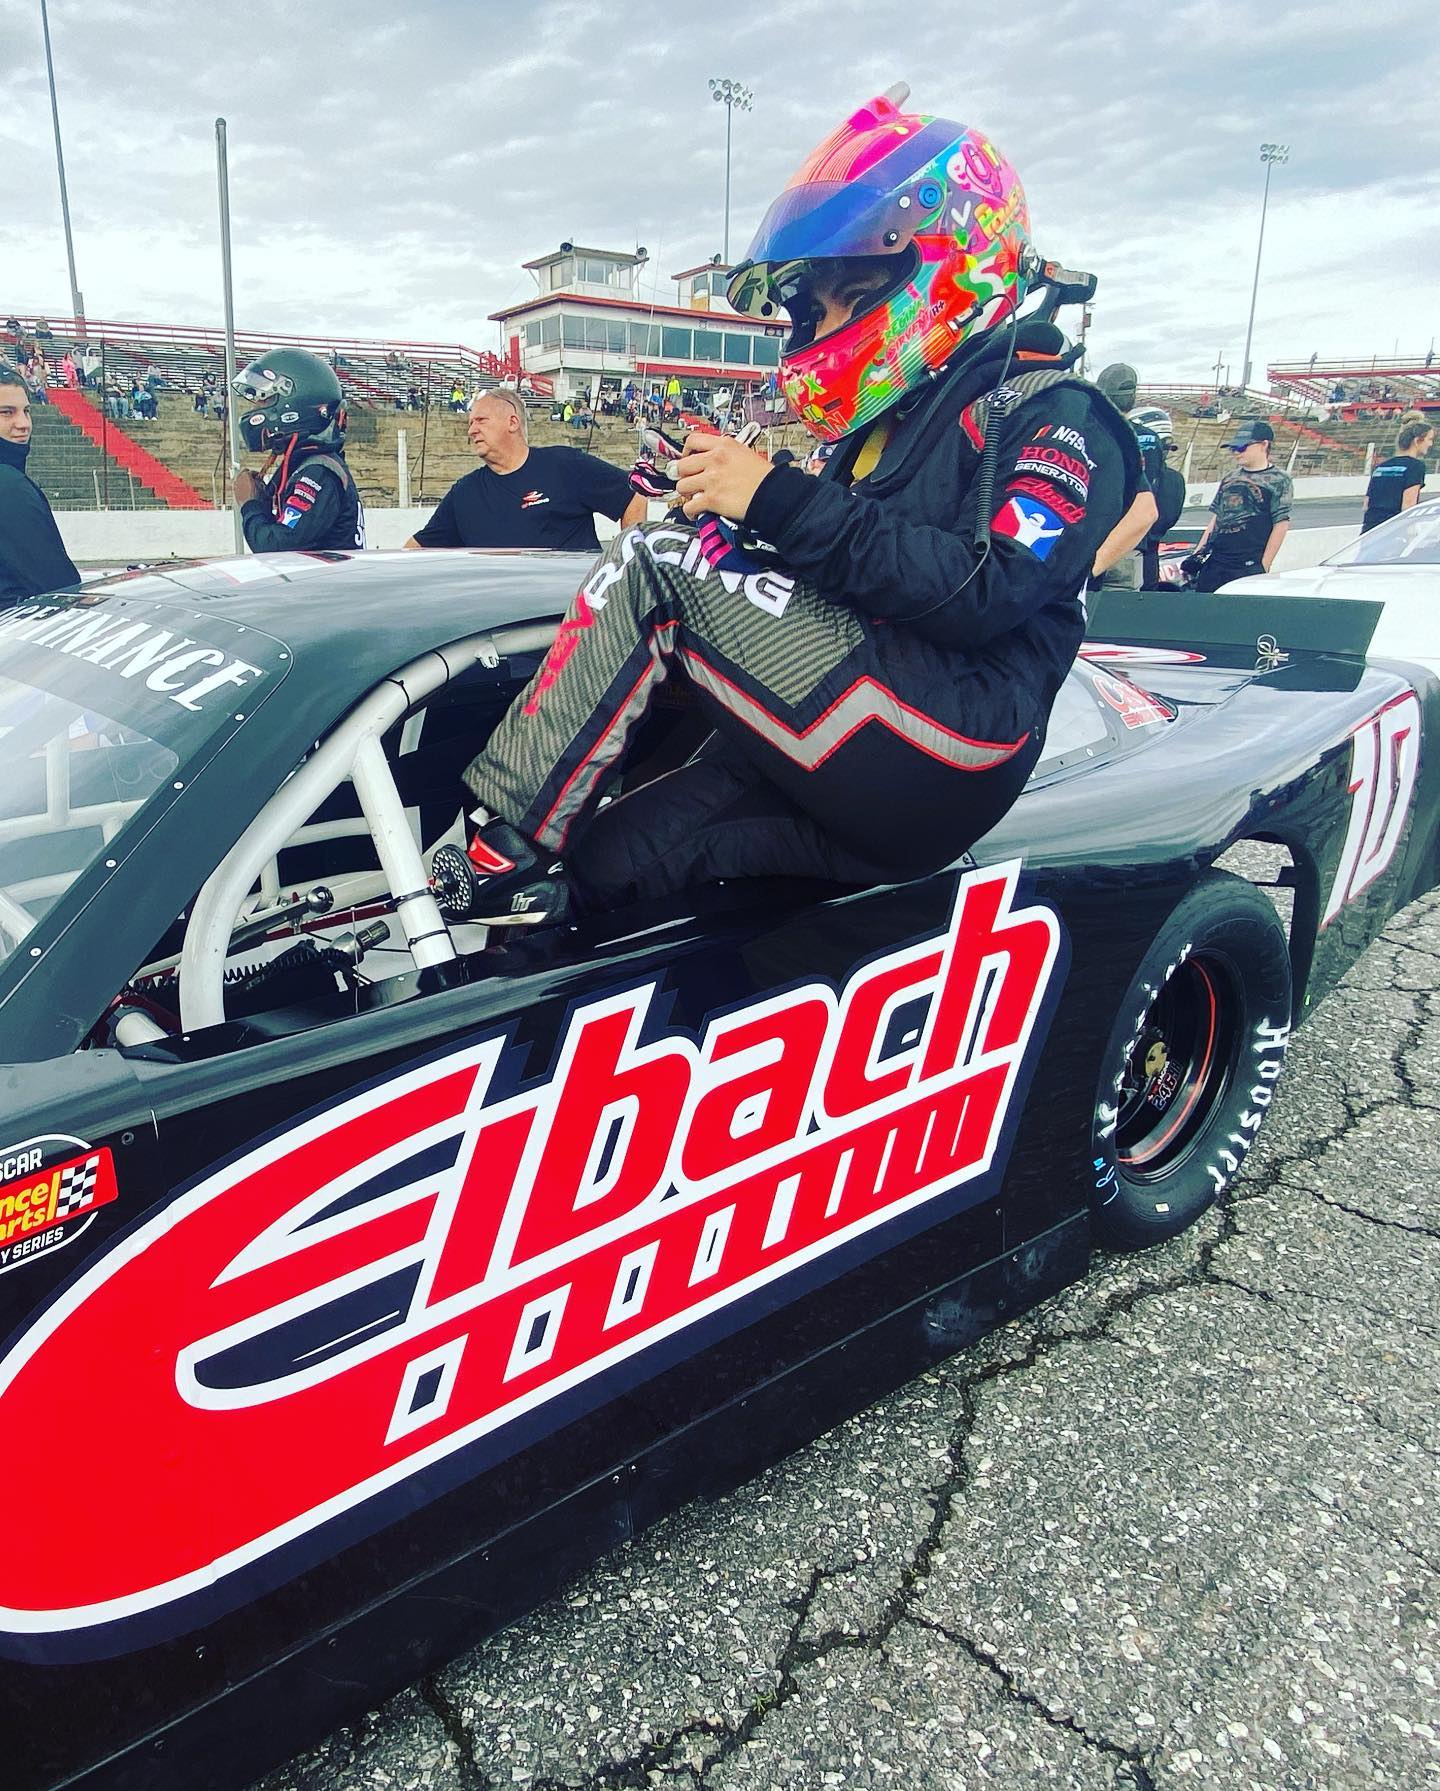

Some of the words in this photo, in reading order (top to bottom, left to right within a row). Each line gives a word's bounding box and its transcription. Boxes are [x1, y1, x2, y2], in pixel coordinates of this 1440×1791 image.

[16, 607, 264, 712] FINANCE
[0, 857, 1063, 1633] Eibach
[12, 1226, 64, 1260] SERIES
